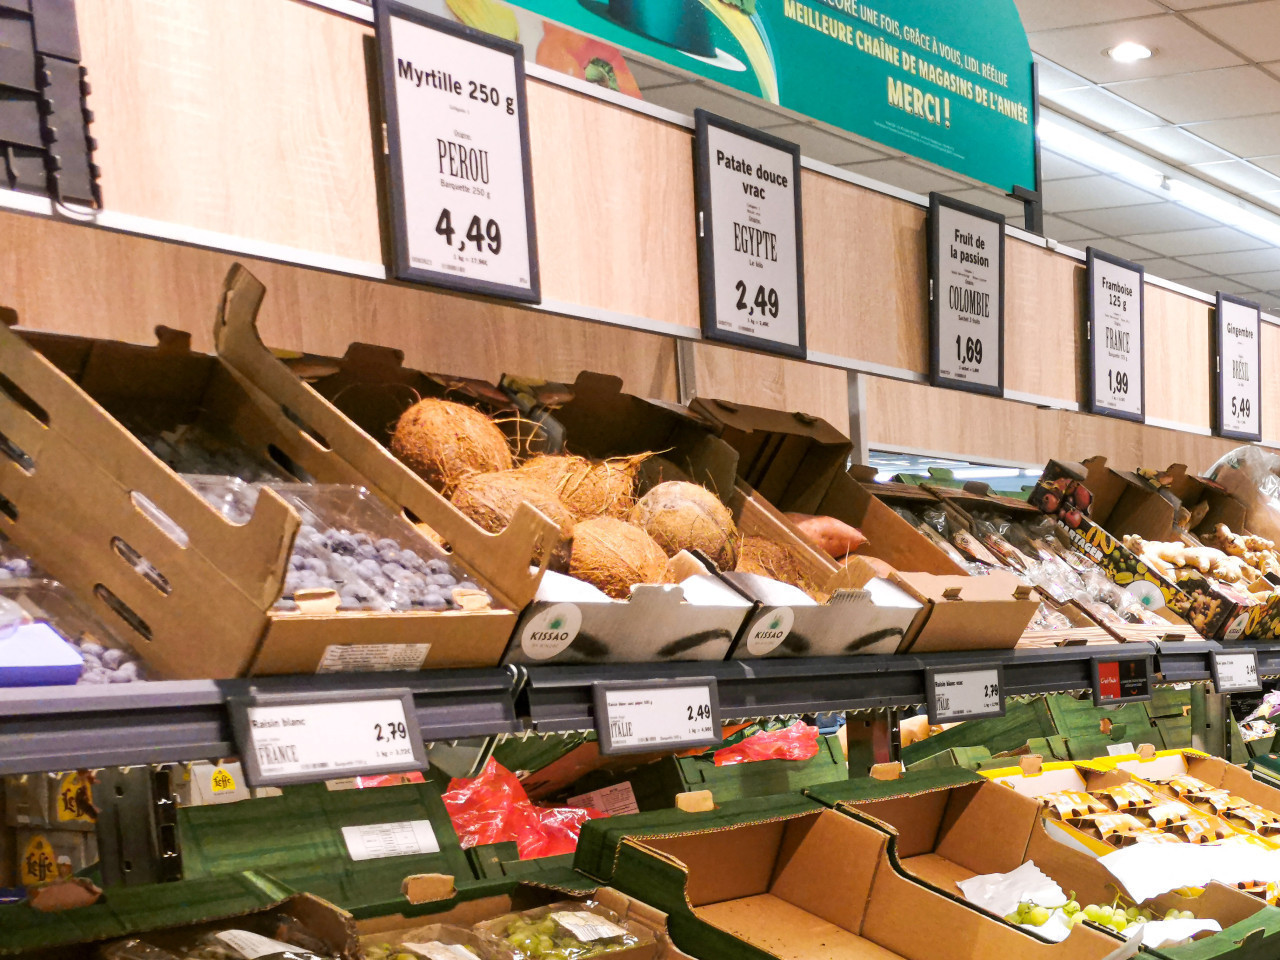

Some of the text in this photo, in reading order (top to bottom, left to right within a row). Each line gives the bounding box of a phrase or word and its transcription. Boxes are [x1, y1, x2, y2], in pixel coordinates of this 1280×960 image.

[824, 0, 1008, 88] ORE UNE FOIS, GRÂCE À VOUS, LIDL RÉÉLUE
[783, 0, 1028, 124] MEILLEURE CHAÎNE DE MAGASINS DE L'ANNÉE
[397, 57, 515, 115] Myrtille 250 g
[887, 76, 941, 125] MERCI
[437, 138, 490, 185] PEROU
[716, 150, 788, 188] Patate douce
[742, 182, 766, 200] vrac
[435, 207, 502, 256] 4,49
[733, 222, 778, 263] EGYPTE
[954, 228, 985, 250] Fruit de
[950, 244, 989, 268] la passion
[1102, 276, 1133, 297] Framboise
[735, 279, 779, 319] 2,49
[949, 285, 990, 318] COLOMBIE
[1108, 294, 1127, 312] 125 g
[1105, 326, 1130, 354] FRANCE
[1226, 322, 1254, 339] Gingembre
[956, 334, 983, 365] 1,69
[1108, 369, 1129, 394] 1,99
[1231, 396, 1251, 418] 5,49
[530, 631, 569, 641] KISSAO
[754, 630, 783, 639] KISSAO
[984, 684, 999, 698] 2,79
[252, 718, 305, 728] Raisin blanc
[687, 703, 711, 721] 2,49
[374, 722, 407, 743] 2,79
[610, 722, 633, 739] ITALIE
[258, 745, 299, 766] FRANCE
